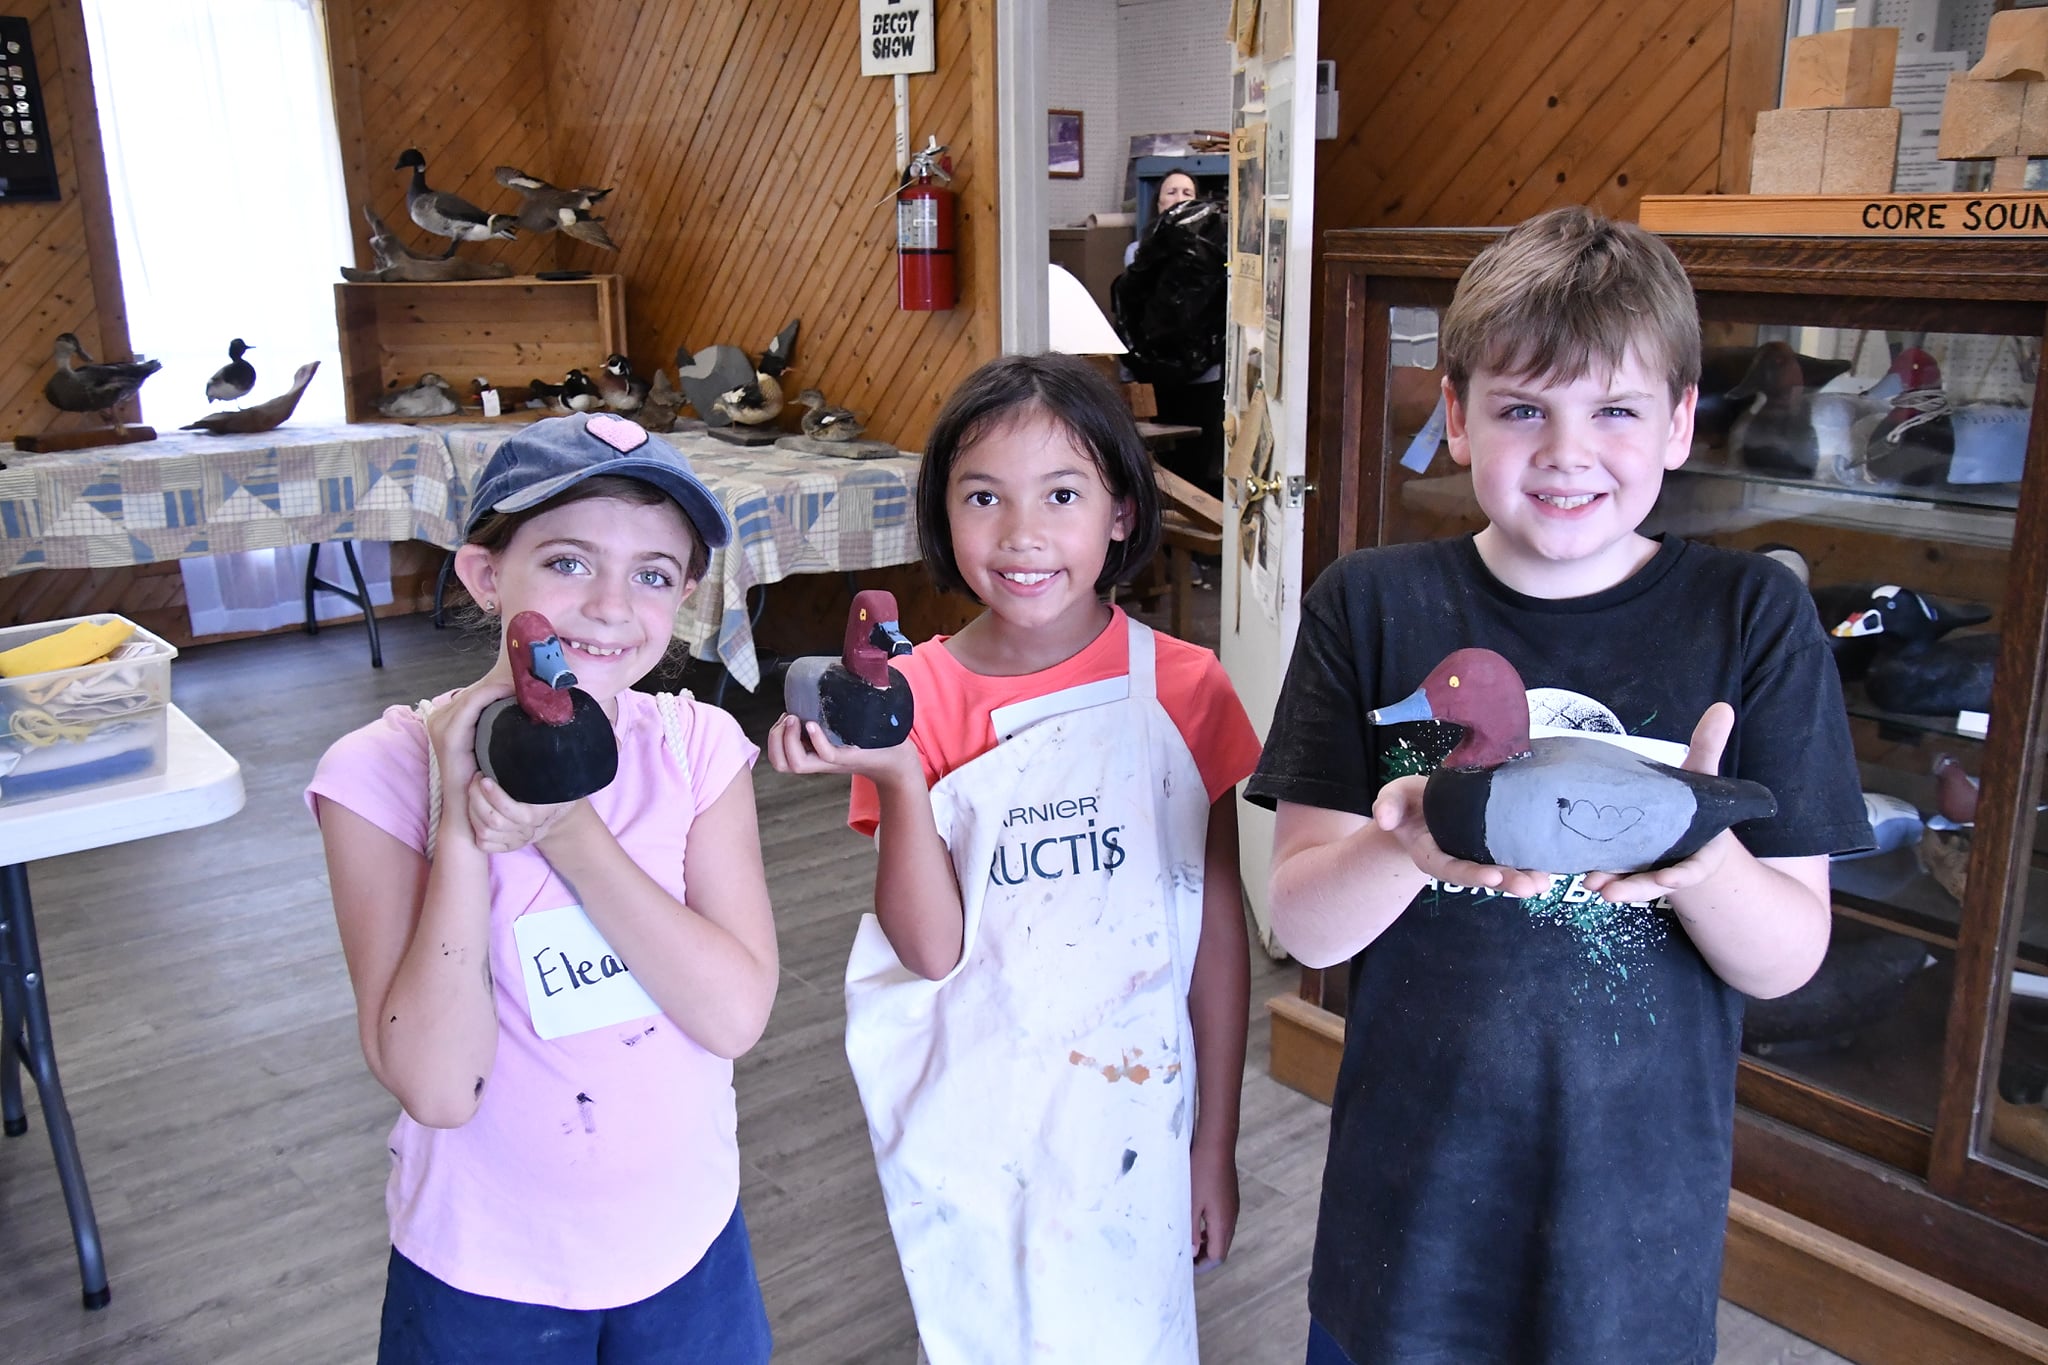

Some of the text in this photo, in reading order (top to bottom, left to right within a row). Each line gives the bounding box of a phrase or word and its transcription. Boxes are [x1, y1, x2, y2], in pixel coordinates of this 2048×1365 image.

[872, 9, 919, 35] DECOY
[872, 35, 915, 59] SHOW
[1862, 203, 1947, 229] CORE
